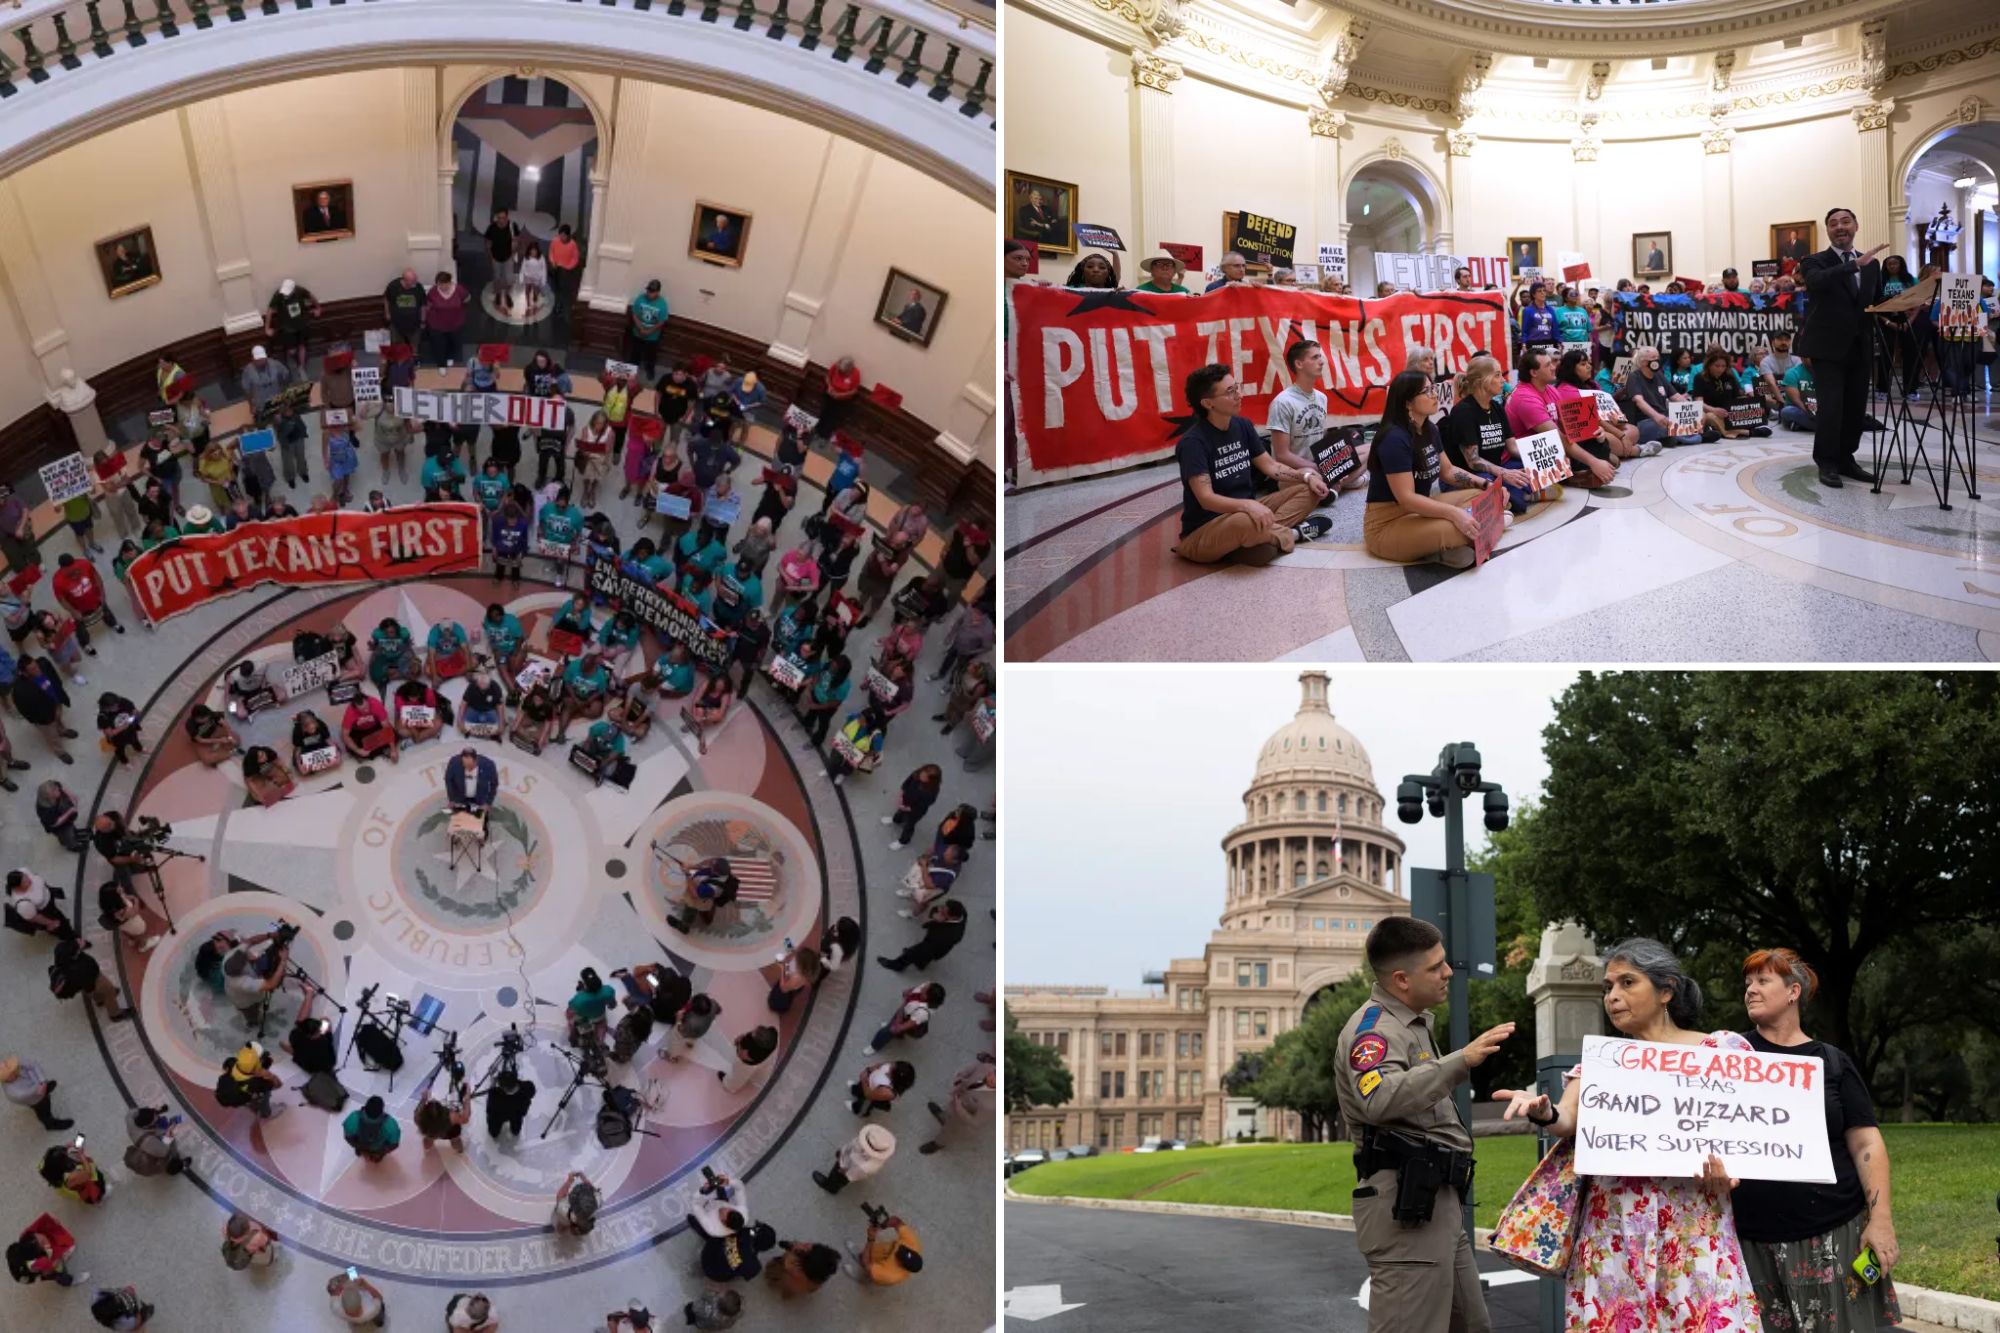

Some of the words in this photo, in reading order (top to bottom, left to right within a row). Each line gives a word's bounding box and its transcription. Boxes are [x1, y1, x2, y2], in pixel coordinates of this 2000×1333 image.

[1246, 213, 1293, 240] DEFEND
[1236, 237, 1294, 260] CONSTITUTION
[1259, 233, 1278, 247] THE
[1320, 246, 1344, 256] MAKE
[1325, 265, 1343, 273] AIR
[1467, 256, 1509, 289] OUT
[1954, 278, 1970, 290] PUT
[1946, 288, 1976, 301] TEXANS
[1951, 299, 1970, 311] FIRST
[1625, 311, 1653, 329] END
[1657, 311, 1799, 333] GERRYMANDERING,
[1624, 331, 1672, 355] SAVE
[1679, 331, 1796, 355] DEMOCRA
[1041, 323, 1176, 429] PUT
[1199, 314, 1392, 398] TEXANS
[1400, 310, 1498, 380] FIRST
[507, 395, 565, 429] OUT
[1674, 410, 1699, 420] TEXANS
[1681, 404, 1693, 412] PUT
[1730, 403, 1750, 412] FIGHT
[1749, 402, 1761, 410] THE
[1678, 417, 1697, 426] FIRST
[1731, 418, 1763, 427] TAKEOVER
[1217, 440, 1242, 456] TEXAS
[1318, 444, 1335, 461] FIGHT
[1332, 438, 1347, 452] THE
[1482, 436, 1502, 446] ACTION
[1531, 437, 1547, 450] PUT
[1214, 449, 1250, 469] FREEDOM
[1527, 444, 1560, 463] TEXANS
[1325, 458, 1356, 483] TAKEOVER
[1535, 456, 1558, 472] FIRST
[143, 551, 214, 608] PUT
[217, 532, 361, 578] TEXANS
[367, 517, 470, 561] FIRST
[362, 805, 397, 848] OF
[367, 889, 524, 968] REPUBLIC
[1621, 1044, 1702, 1076] GREG
[1703, 1054, 1817, 1091] ABBOTT
[1669, 1073, 1736, 1094] TEXAS
[1581, 1083, 1662, 1116] GRAND
[1673, 1096, 1791, 1126] WIZZARD
[1677, 1118, 1710, 1132] OF
[1581, 1126, 1648, 1153] VOTER
[1656, 1133, 1803, 1160] SUPRESSION
[320, 1220, 374, 1260] THE
